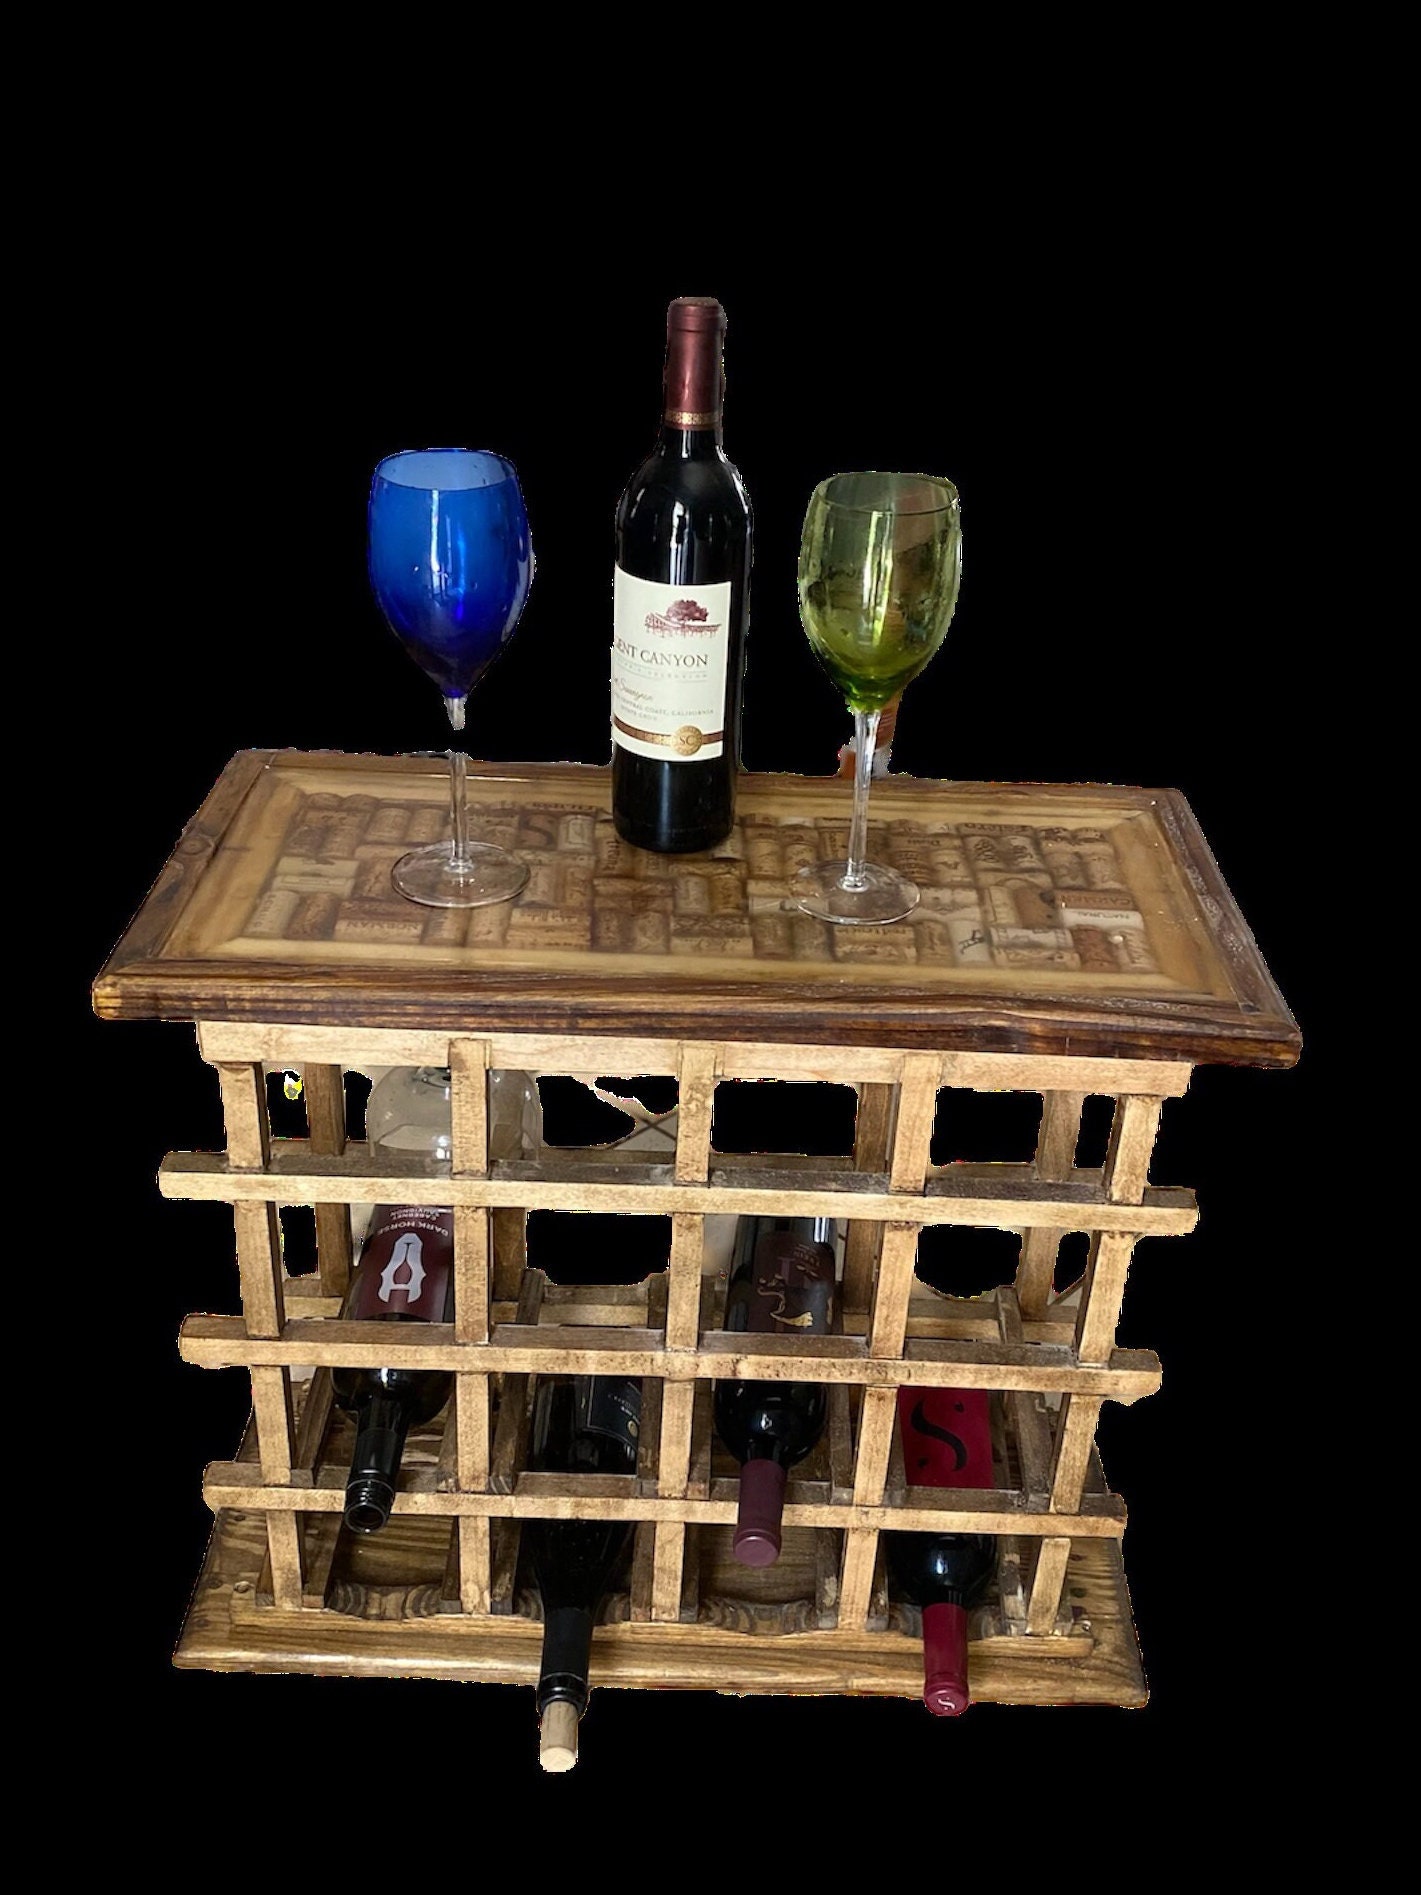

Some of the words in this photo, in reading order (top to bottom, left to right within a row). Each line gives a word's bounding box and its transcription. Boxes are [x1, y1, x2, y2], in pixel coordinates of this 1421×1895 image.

[640, 648, 709, 668] CANYON
[679, 735, 695, 745] SC
[378, 1220, 416, 1235] HORSE
[418, 1221, 449, 1237] DARK
